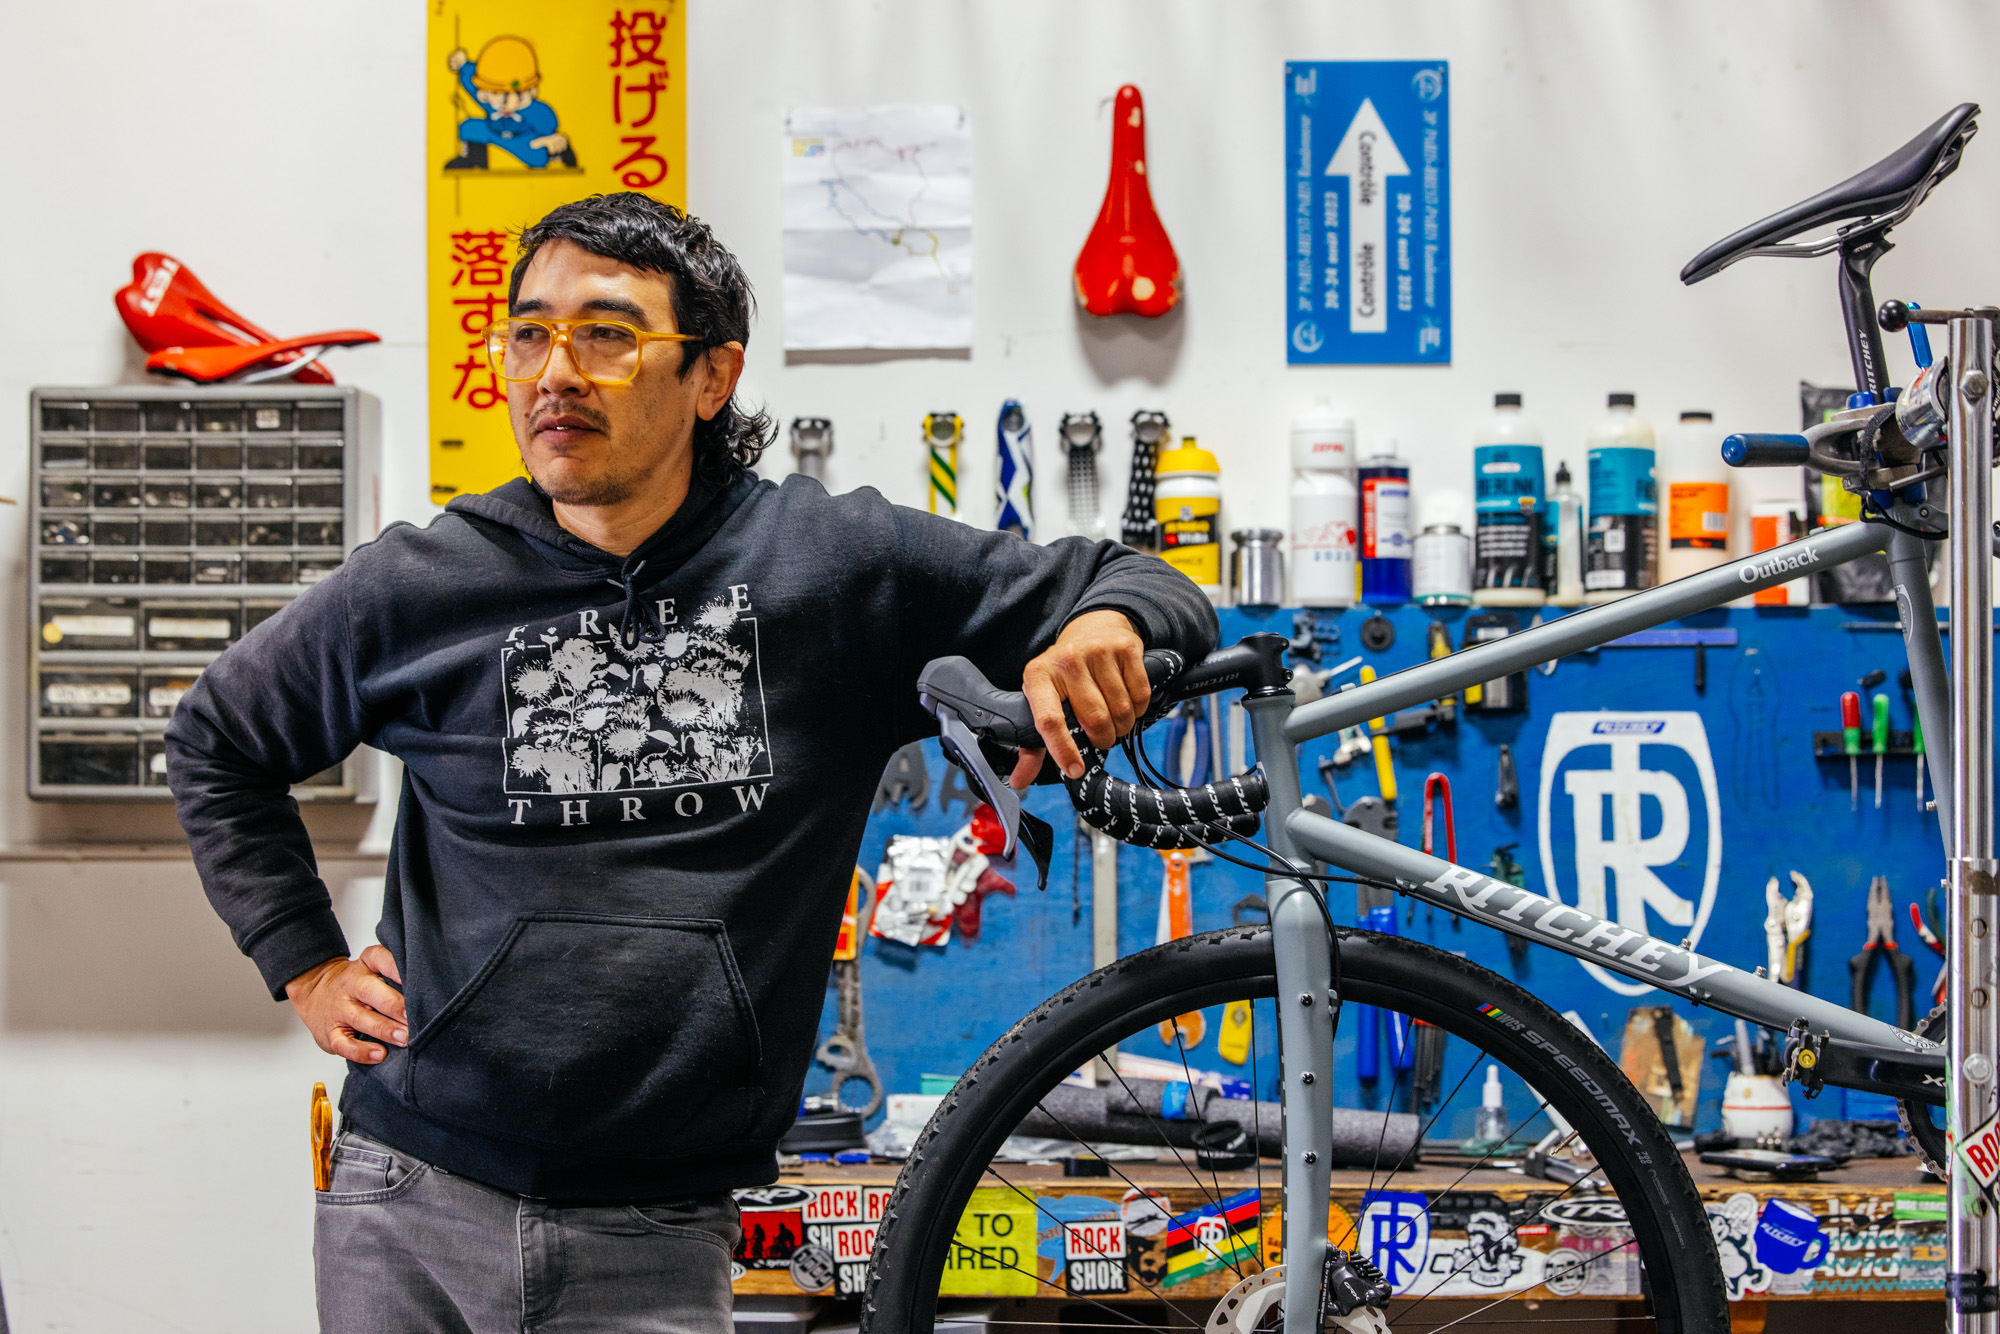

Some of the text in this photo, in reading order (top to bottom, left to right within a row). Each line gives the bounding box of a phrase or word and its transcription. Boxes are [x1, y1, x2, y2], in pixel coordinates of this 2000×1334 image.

[1858, 328, 1878, 395] RITCHEY
[1738, 546, 1820, 584] Outback
[508, 782, 771, 826] THROW
[1422, 864, 1734, 988] RITCHEY
[1498, 1012, 1643, 1146] WCS SPEEDMAX
[1966, 1122, 2000, 1179] RO
[807, 1190, 858, 1219] ROCK
[868, 1193, 893, 1221] RO
[1560, 1206, 1630, 1220] TR
[806, 1224, 833, 1252] SH
[973, 1213, 1014, 1237] TO
[838, 1229, 875, 1257] ROC
[1069, 1227, 1123, 1255] ROCK
[839, 1263, 870, 1294] SH
[1069, 1260, 1124, 1293] SHOX
